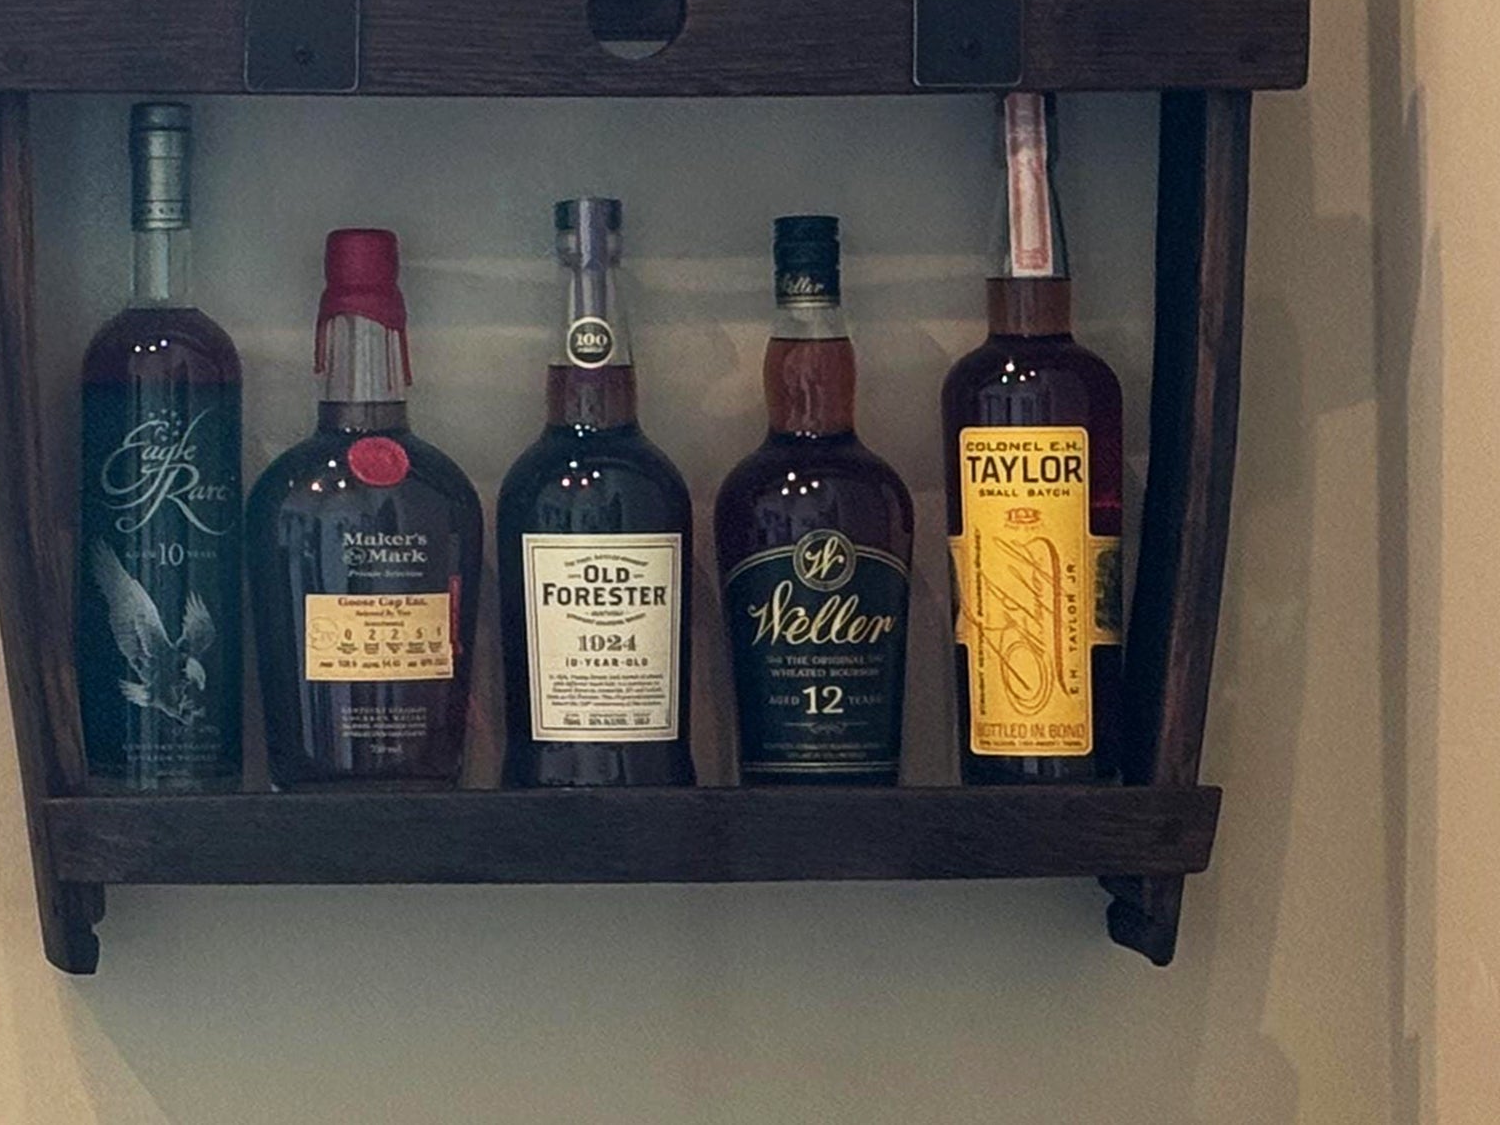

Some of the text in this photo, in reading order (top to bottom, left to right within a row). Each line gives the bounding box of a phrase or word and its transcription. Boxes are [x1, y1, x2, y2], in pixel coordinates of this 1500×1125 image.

[575, 332, 608, 347] 100
[966, 441, 1082, 452] COLONEL E.H.
[966, 456, 1083, 483] TAYLOR
[978, 488, 1071, 497] SMALL BATCH
[342, 532, 428, 546] Maker's
[158, 542, 184, 566] 10
[368, 548, 429, 563] Mark
[583, 564, 630, 584] OLD
[1066, 564, 1077, 583] JR
[543, 583, 667, 606] FORESTER
[748, 579, 897, 646] Weller
[1066, 594, 1078, 653] TAYLOR
[344, 629, 352, 641] 0
[368, 629, 377, 641] 2
[391, 629, 400, 641] 2
[768, 695, 800, 706] AGED
[802, 685, 844, 714] 12
[976, 723, 1086, 739] BOTTLED IN BOND
